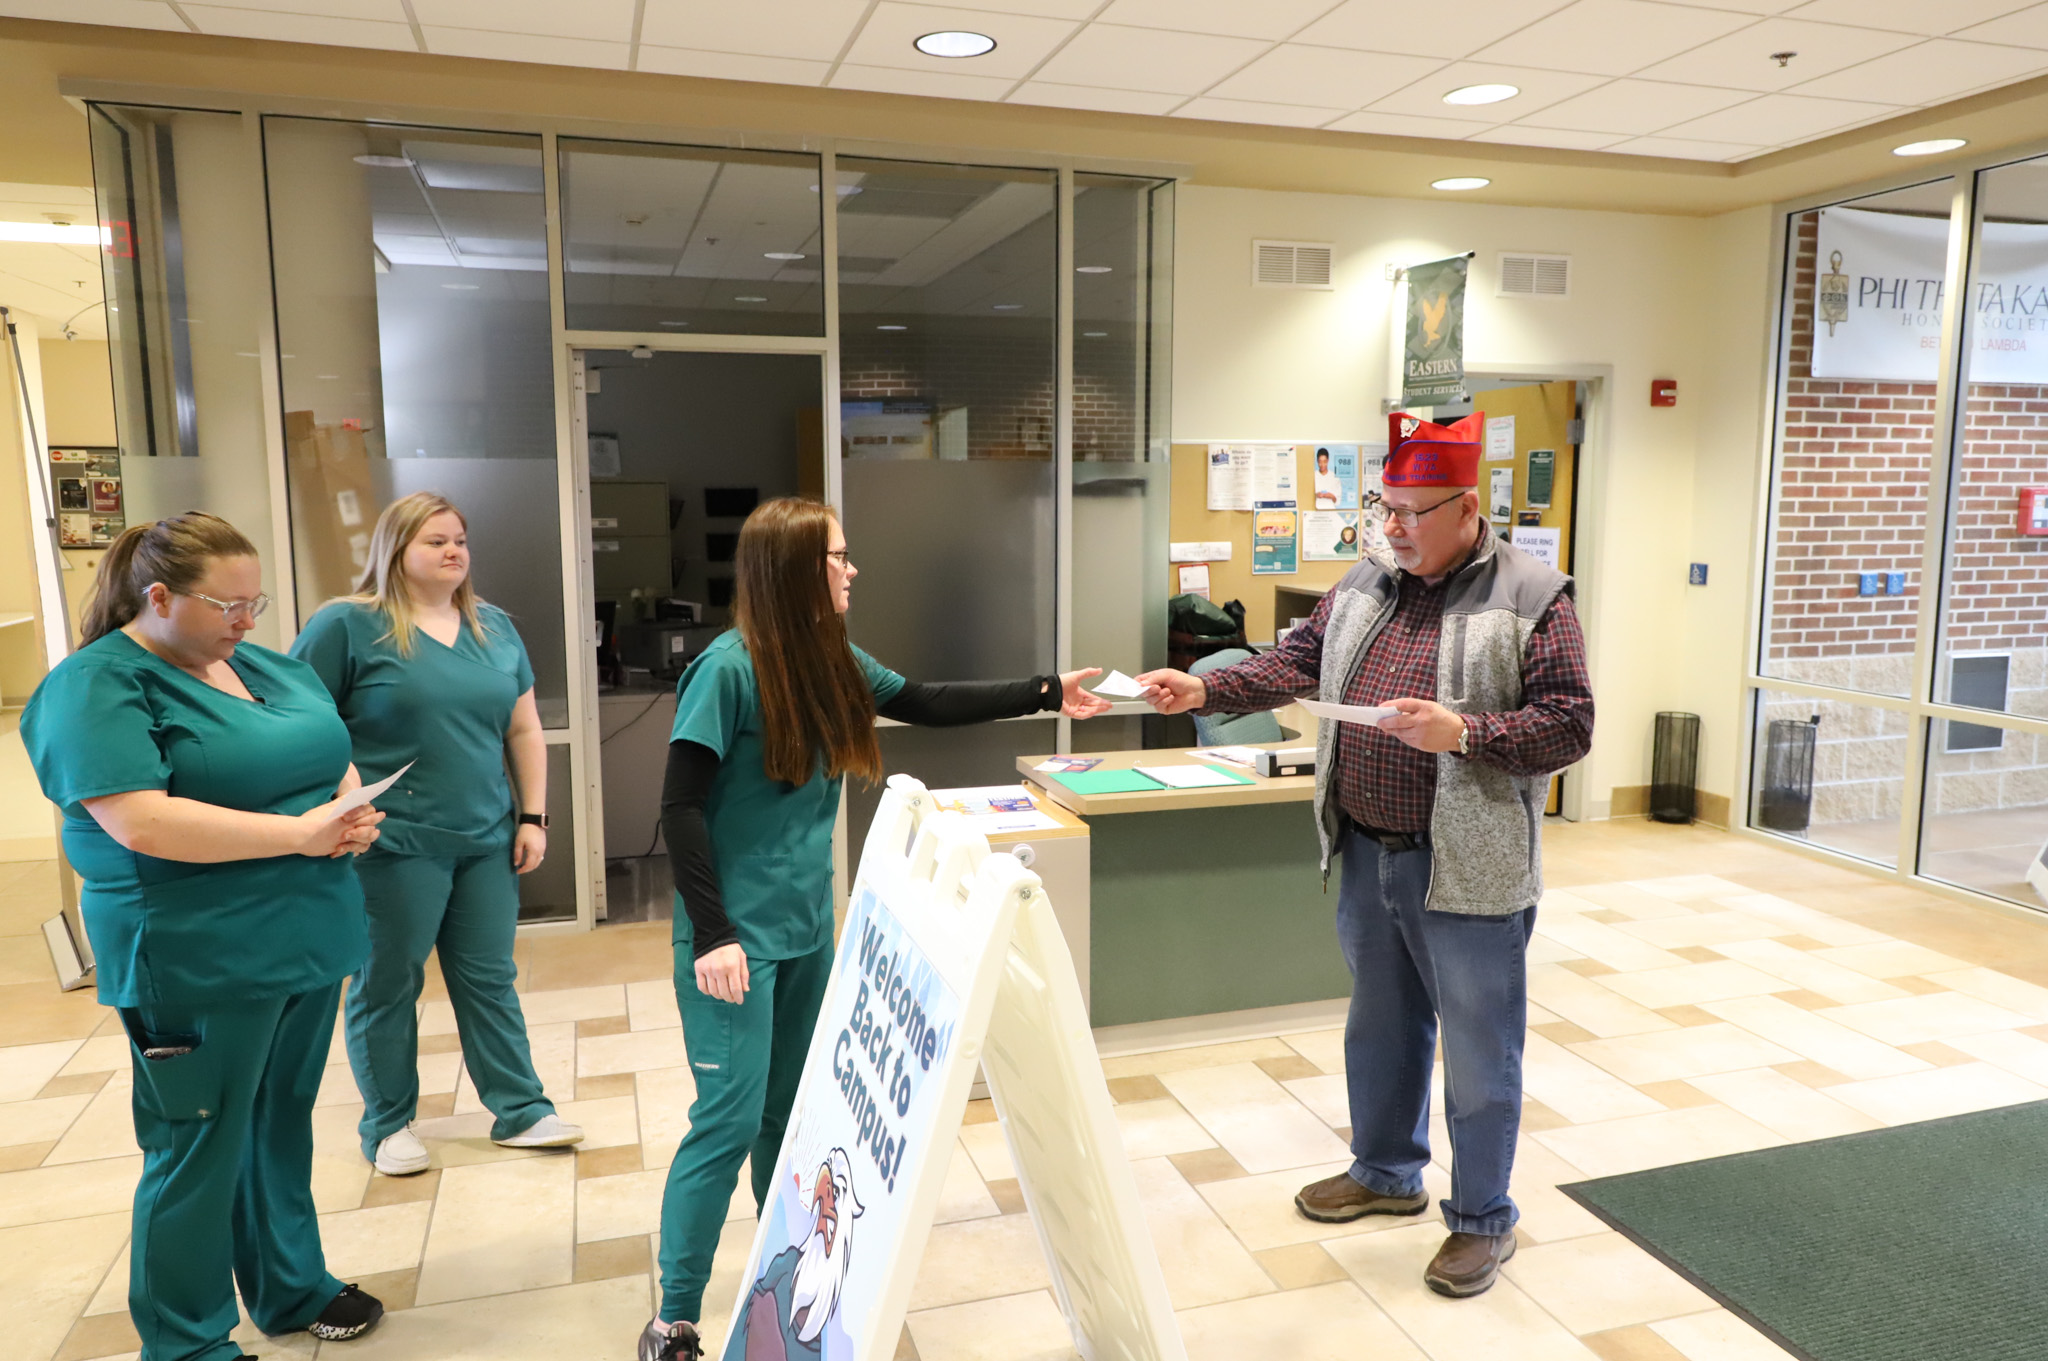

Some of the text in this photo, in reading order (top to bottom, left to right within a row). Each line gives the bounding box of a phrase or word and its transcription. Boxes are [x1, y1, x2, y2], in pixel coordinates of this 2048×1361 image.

[1859, 276, 1908, 309] PHI
[1980, 338, 2026, 351] LAMBDA
[1409, 358, 1457, 377] EASTERN
[1404, 384, 1464, 397] STUDENT SERVICES
[1516, 537, 1554, 547] PLEASE RING
[1535, 549, 1548, 557] FOR
[859, 915, 936, 1072] Welcome
[849, 980, 911, 1119] Back to
[833, 1028, 907, 1195] Campus!
